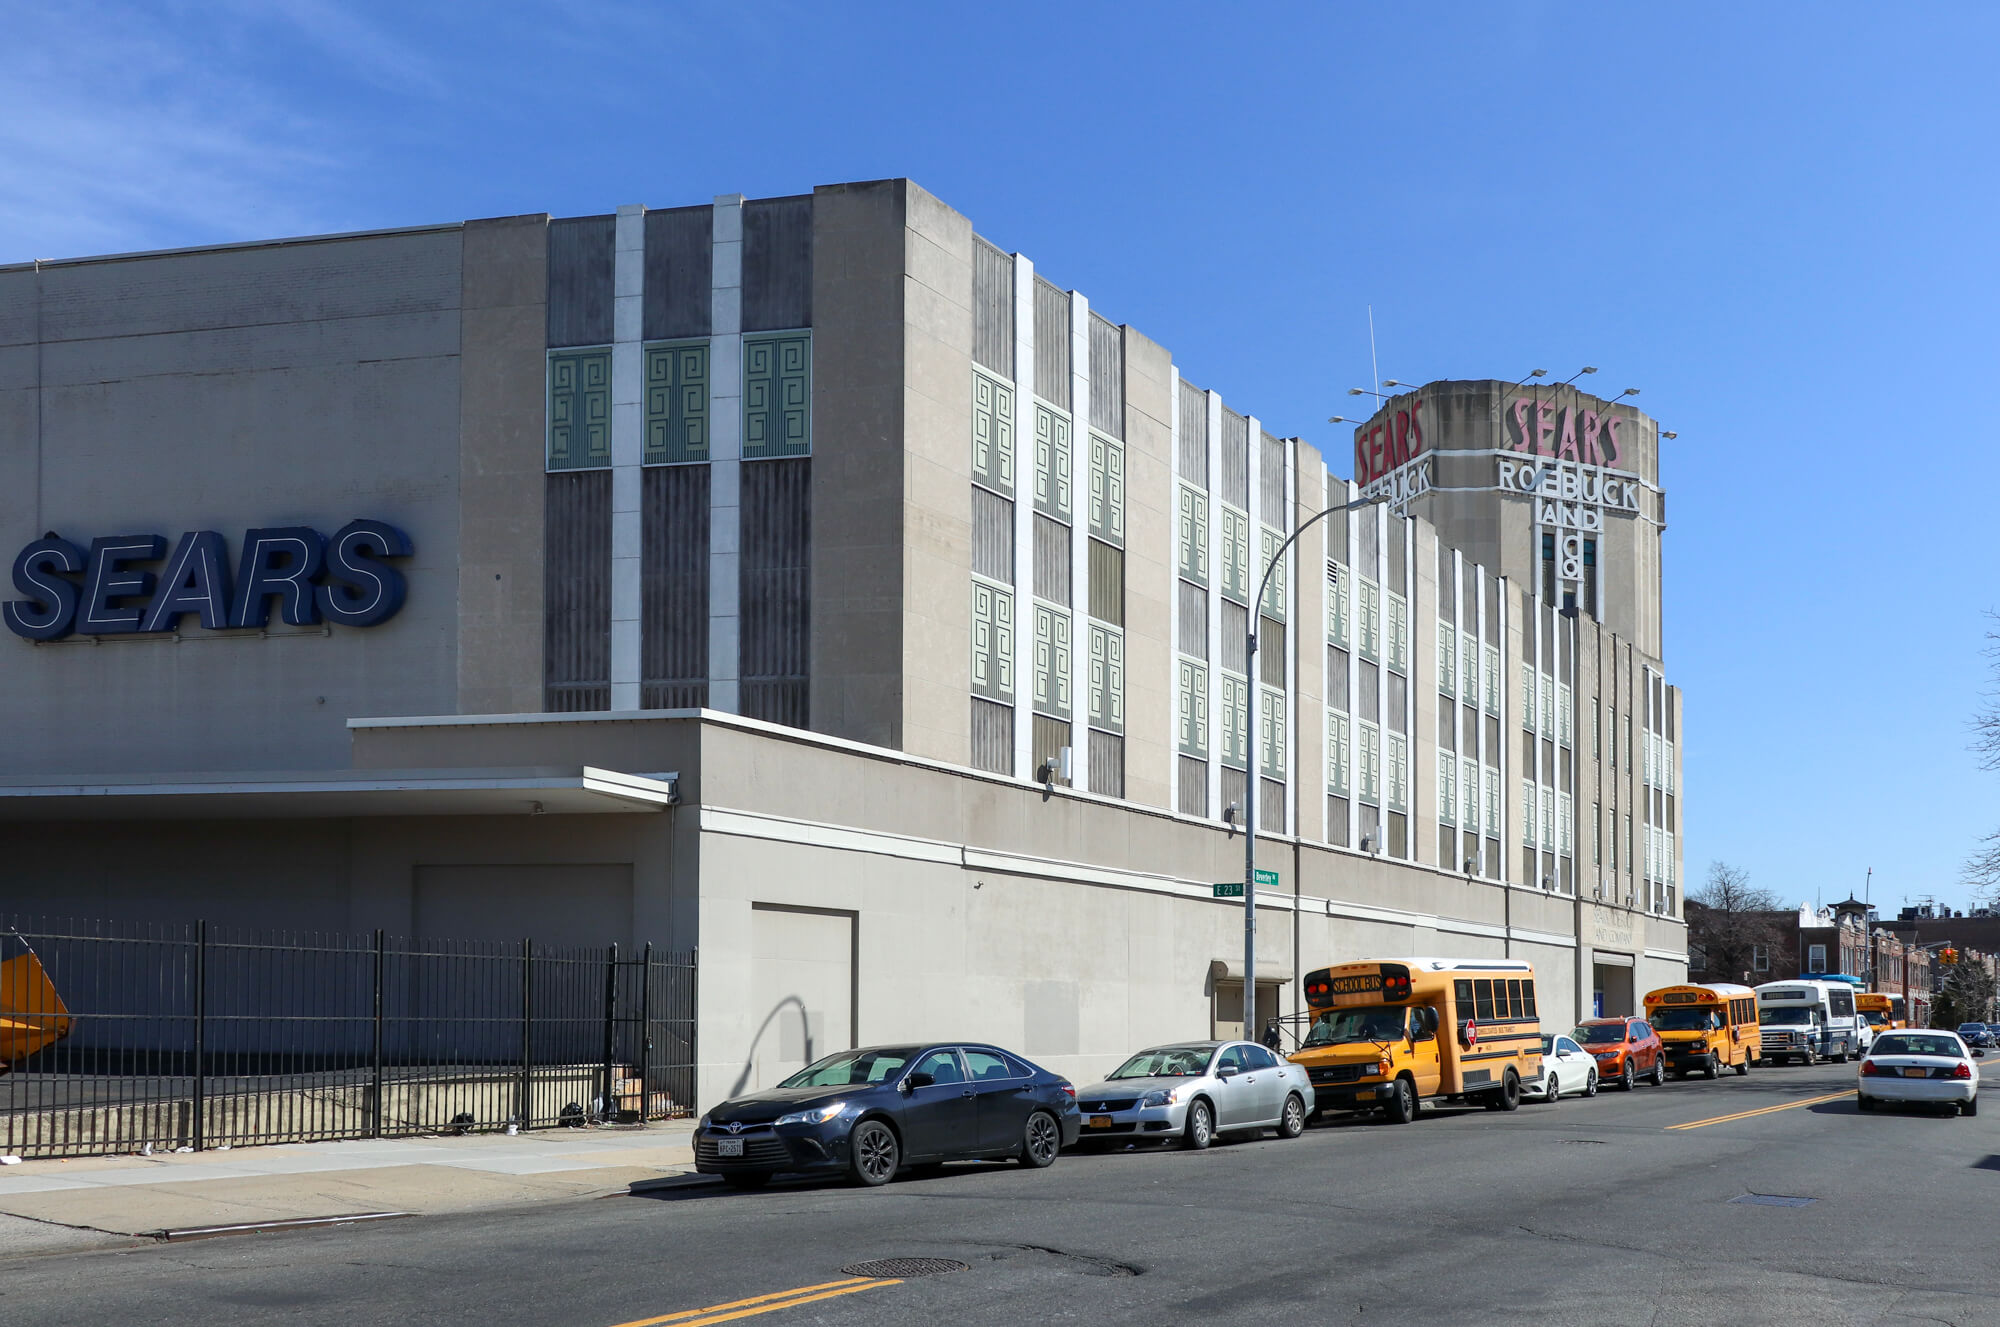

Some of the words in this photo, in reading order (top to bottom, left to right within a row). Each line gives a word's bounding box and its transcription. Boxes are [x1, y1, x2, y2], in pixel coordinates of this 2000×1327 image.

[1357, 400, 1422, 489] SEARS
[1514, 398, 1622, 468] SEARS
[1499, 461, 1639, 510] ROEBUCK
[1542, 503, 1599, 529] AND
[2, 518, 414, 640] SEARS
[1216, 885, 1222, 896] E
[1224, 885, 1233, 896] 23
[1333, 977, 1365, 993] SCHOOL
[1365, 975, 1382, 991] BUS
